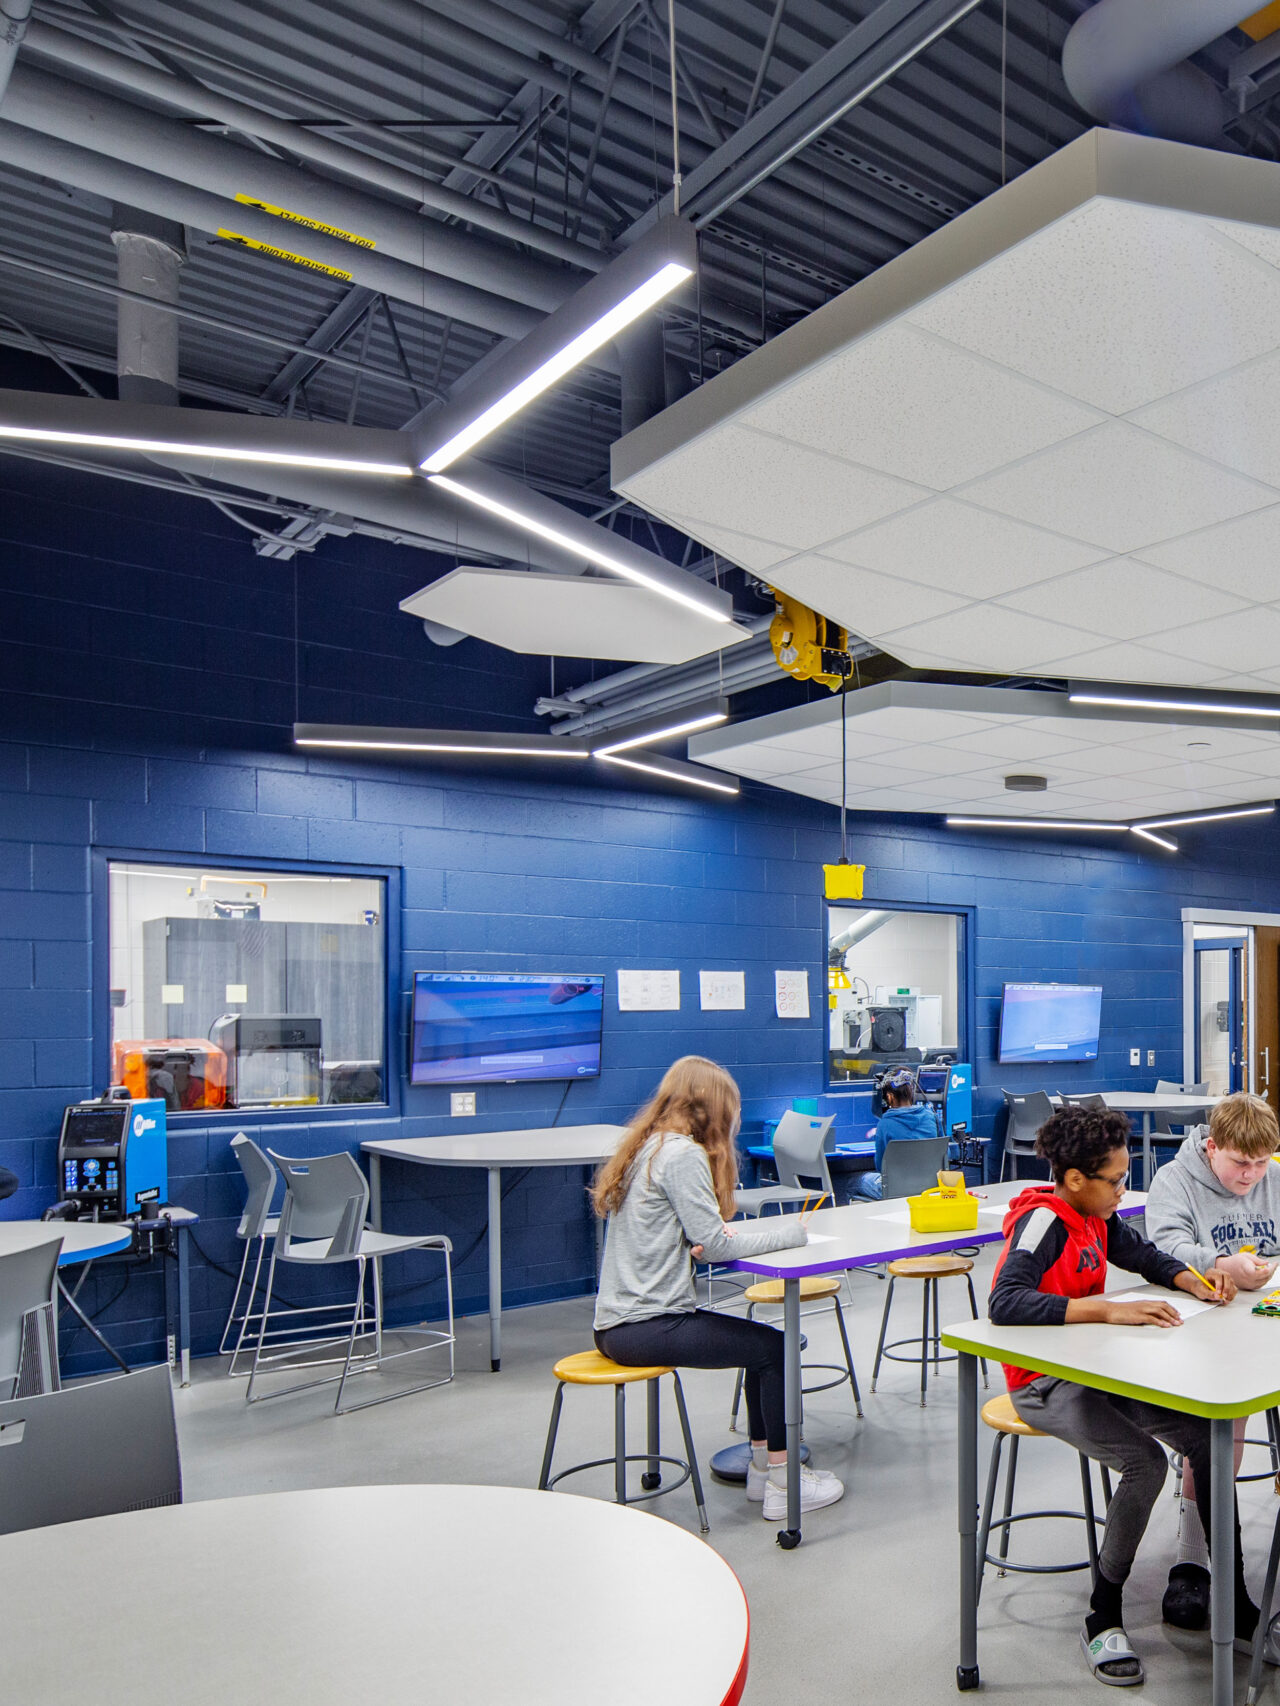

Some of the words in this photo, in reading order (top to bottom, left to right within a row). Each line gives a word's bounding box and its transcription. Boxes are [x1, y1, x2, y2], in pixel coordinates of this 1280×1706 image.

[279, 211, 316, 229] SUPPLY
[318, 224, 353, 242] WATER
[354, 237, 373, 249] HOT
[258, 244, 297, 262] RETURN
[299, 257, 330, 274] WATER
[332, 270, 350, 281] HOT
